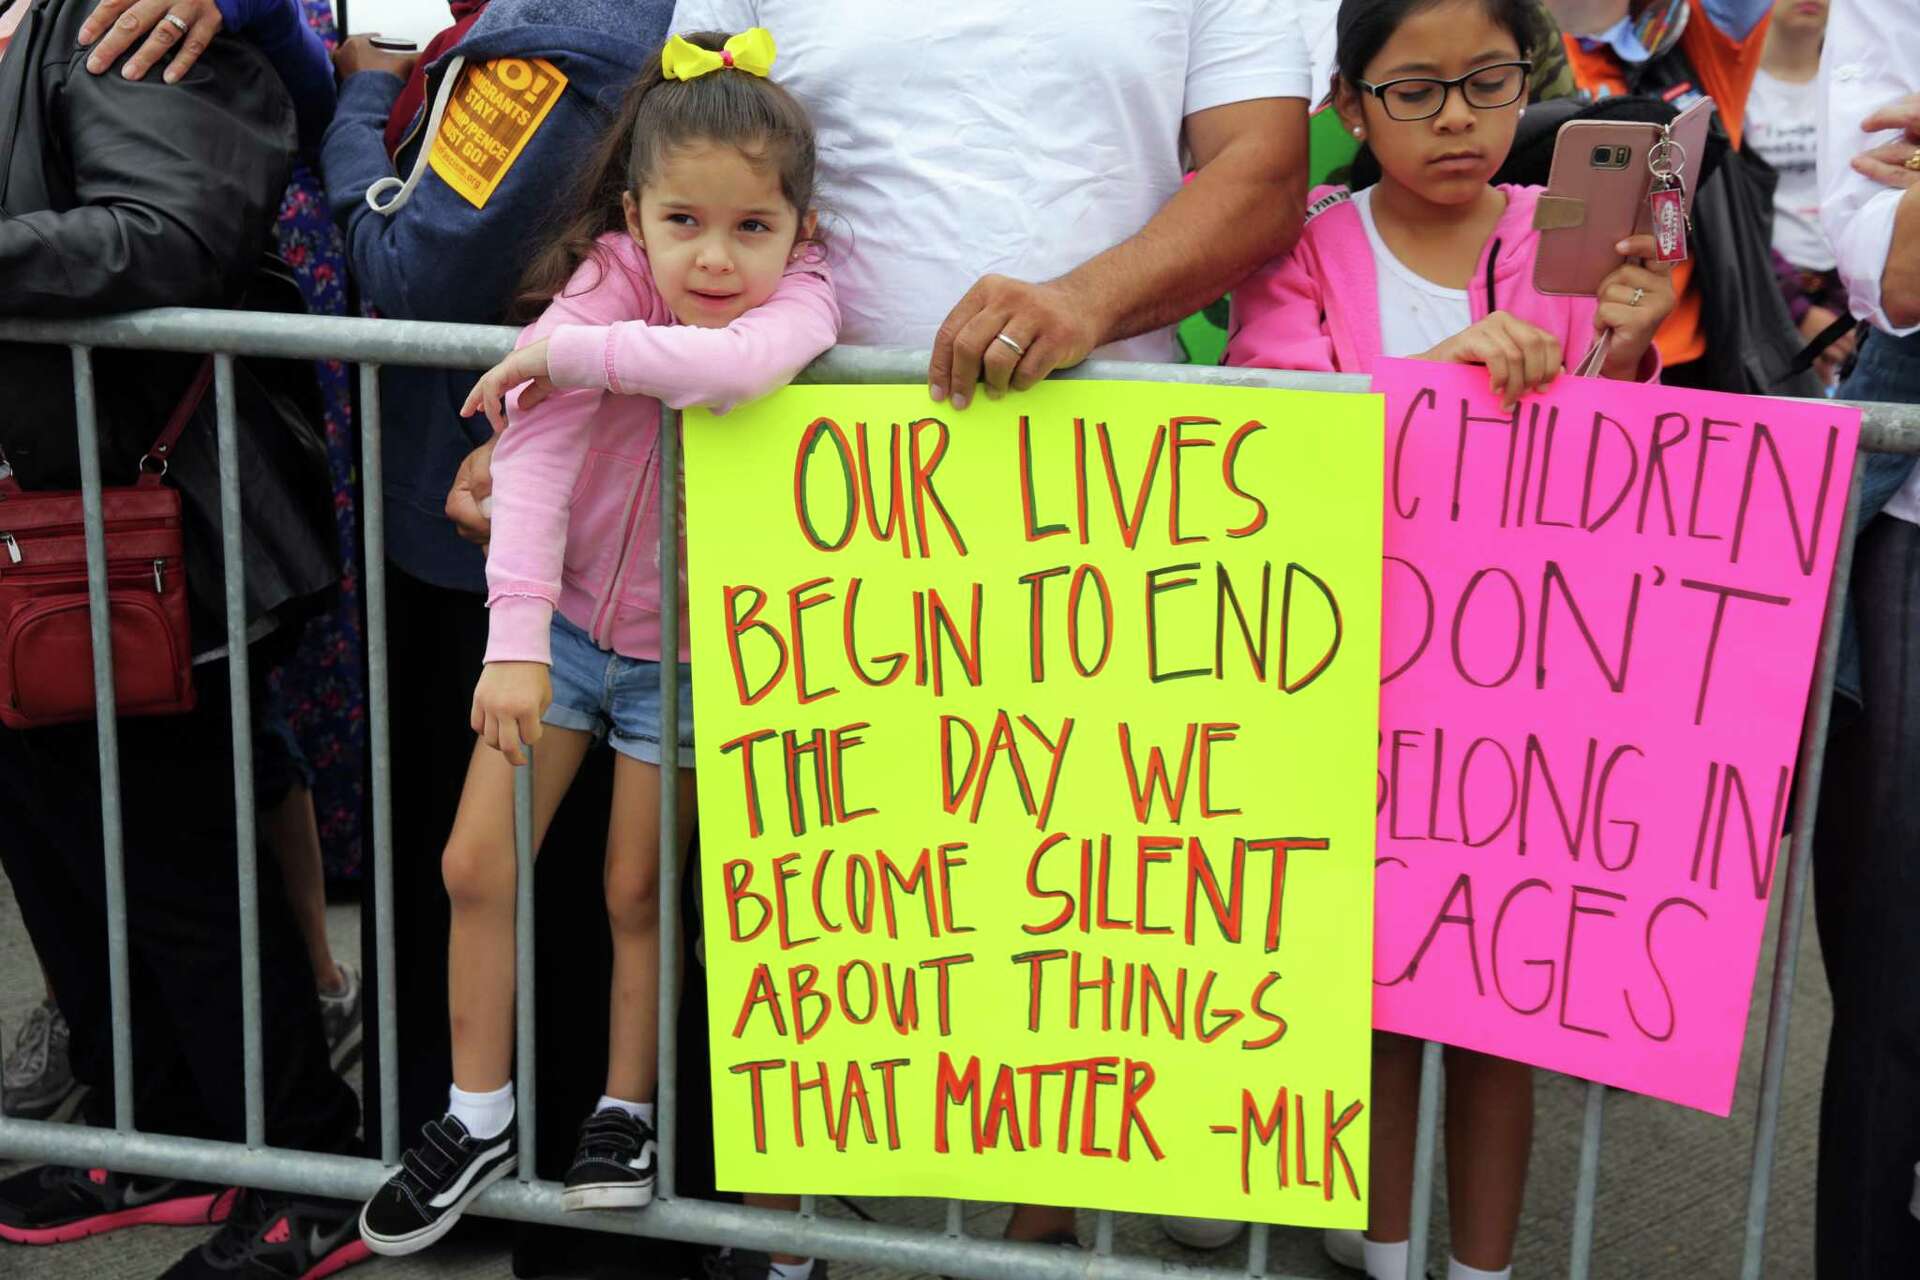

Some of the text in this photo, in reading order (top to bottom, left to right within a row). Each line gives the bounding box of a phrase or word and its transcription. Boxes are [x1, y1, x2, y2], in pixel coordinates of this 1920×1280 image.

[464, 87, 499, 125] STAY!
[486, 58, 549, 104] O!
[462, 142, 488, 167] GO!
[794, 416, 1267, 558] OUR LIVES
[1393, 388, 1838, 577] CHILDREN
[724, 562, 1342, 705] BEGIN TO END
[1380, 556, 1790, 725] DON'T
[720, 709, 1241, 838] THE DAY WE
[1691, 762, 1788, 900] IN
[724, 833, 1329, 953] BECOME SILENT
[733, 950, 1287, 1050] ABOUT THINGS
[729, 1059, 910, 1153] THAT
[935, 1052, 1165, 1162] MATTER
